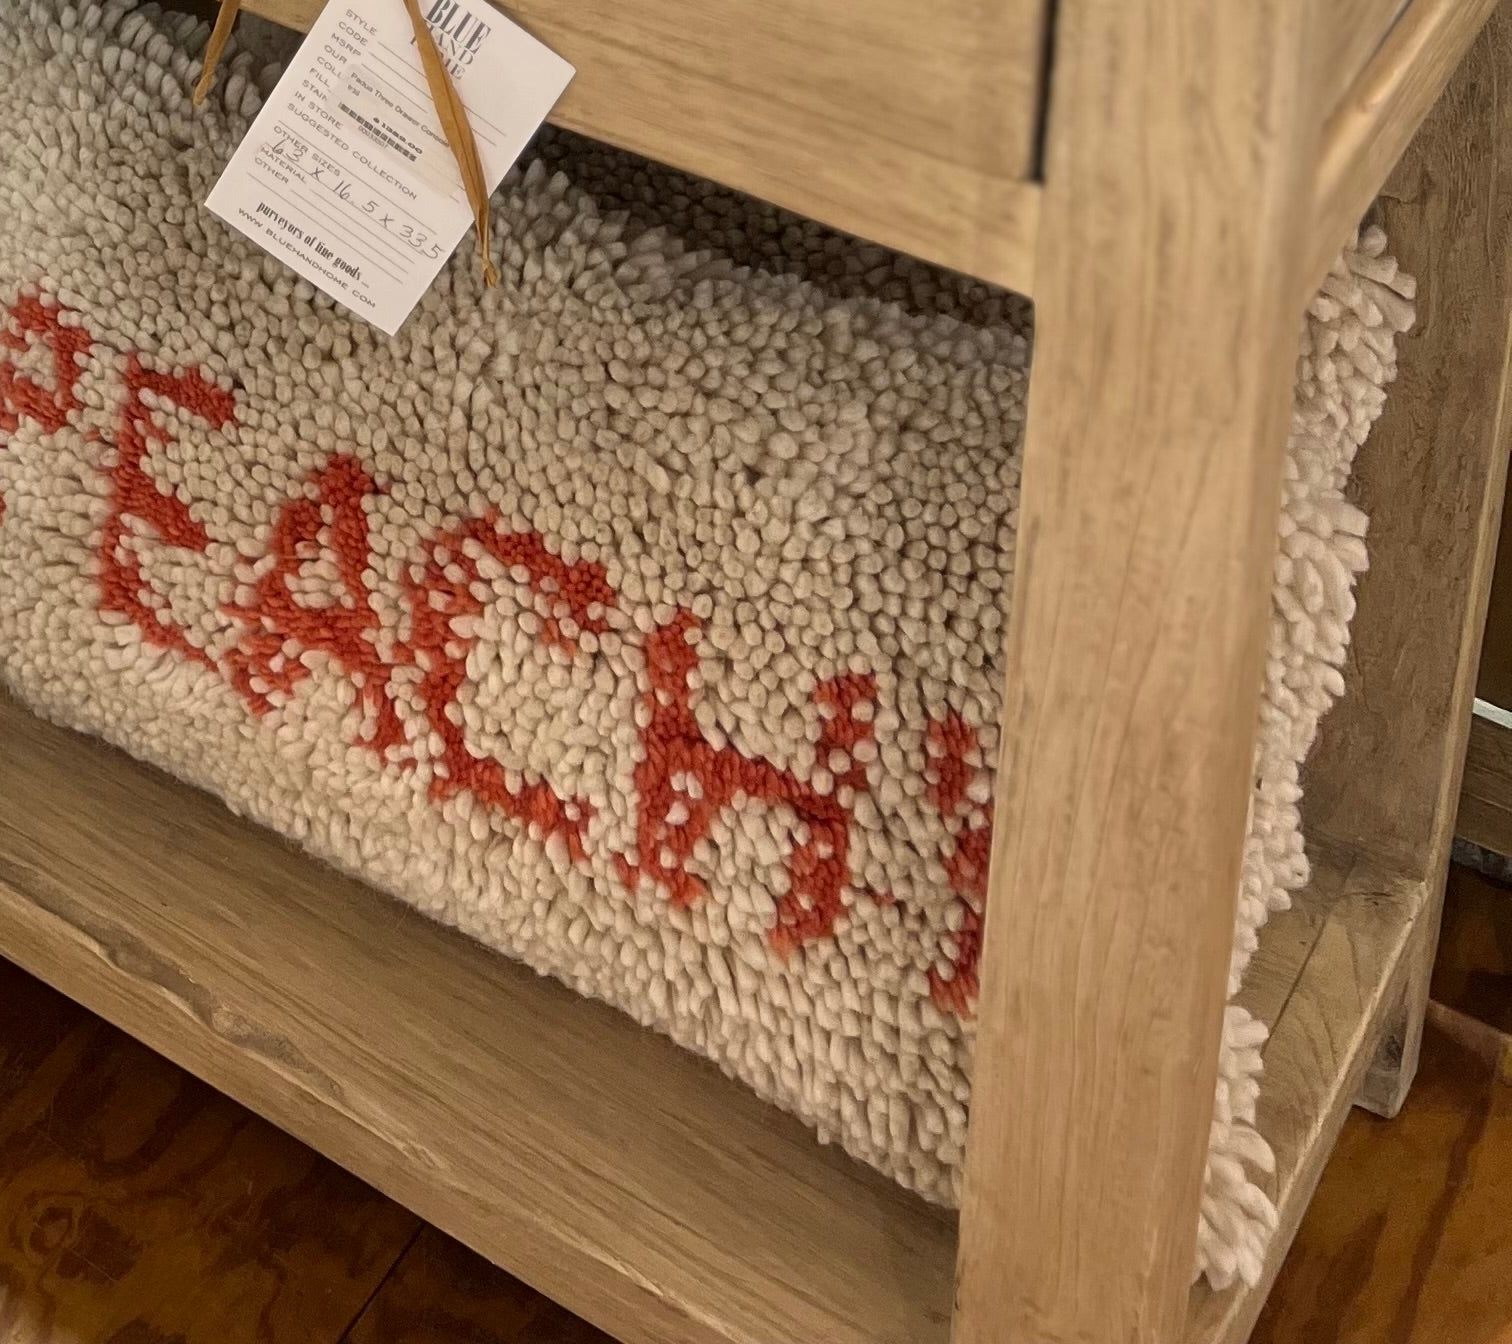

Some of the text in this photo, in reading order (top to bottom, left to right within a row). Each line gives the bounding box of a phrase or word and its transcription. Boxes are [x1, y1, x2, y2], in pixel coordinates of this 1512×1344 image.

[338, 21, 367, 45] CODE
[345, 9, 376, 34] STYLE
[323, 45, 346, 63] OUR
[331, 33, 360, 56] MSRP
[295, 91, 342, 129] IN STORE
[374, 90, 393, 107] Three
[394, 105, 420, 126] Drawer
[260, 147, 306, 182] MATERIAL
[273, 126, 340, 176] OTHER SIZES
[287, 103, 417, 199] SUGGESTED COLLECTION
[253, 157, 288, 183] OTHER
[256, 202, 304, 239] purveyors
[304, 234, 316, 245] of
[316, 242, 334, 259] fine
